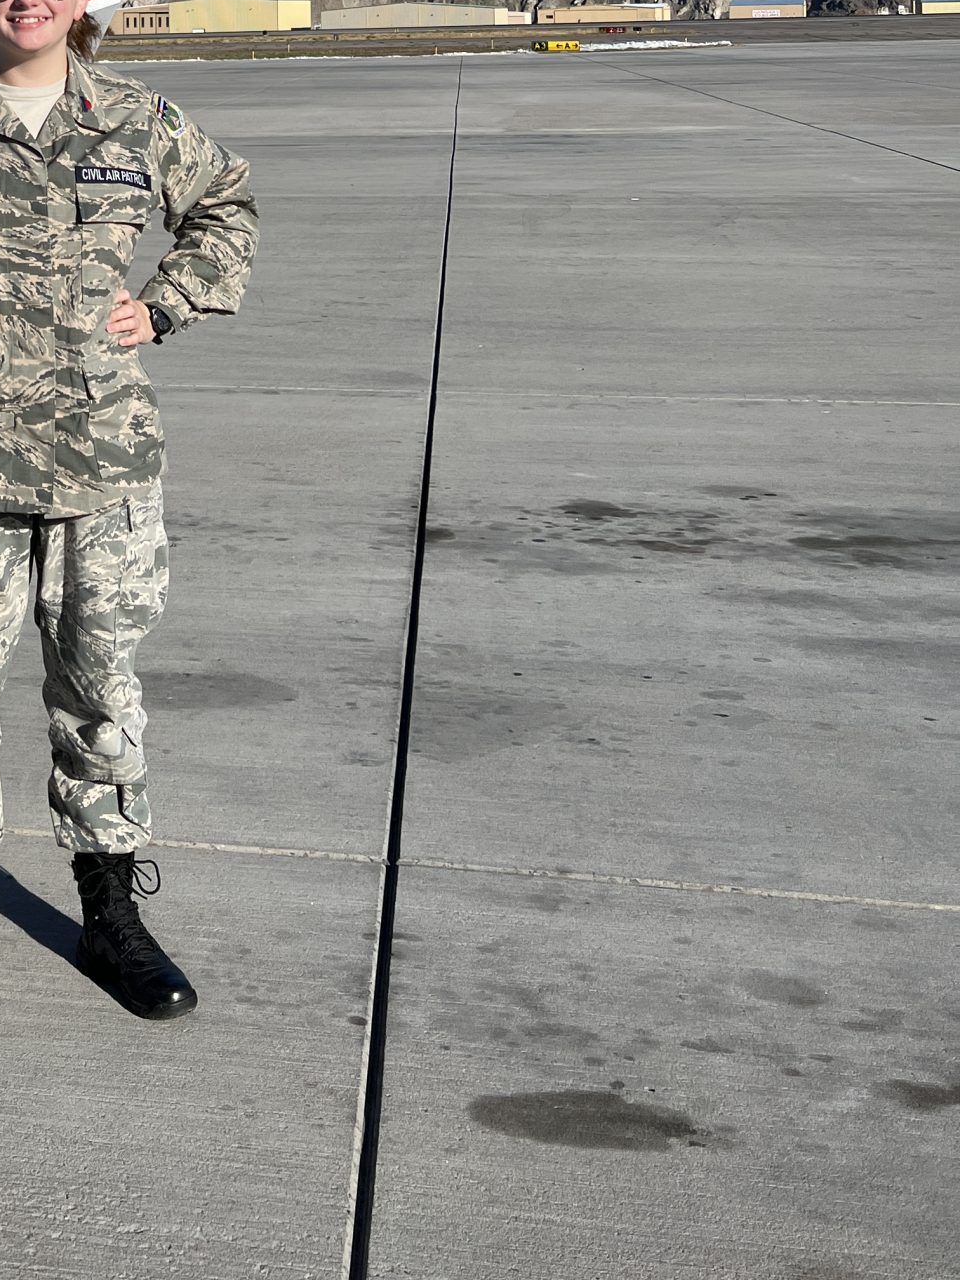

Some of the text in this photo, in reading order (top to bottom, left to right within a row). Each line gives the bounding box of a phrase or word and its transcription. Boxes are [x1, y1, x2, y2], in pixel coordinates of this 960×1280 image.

[82, 168, 147, 187] CIVIL AIR PATROL
